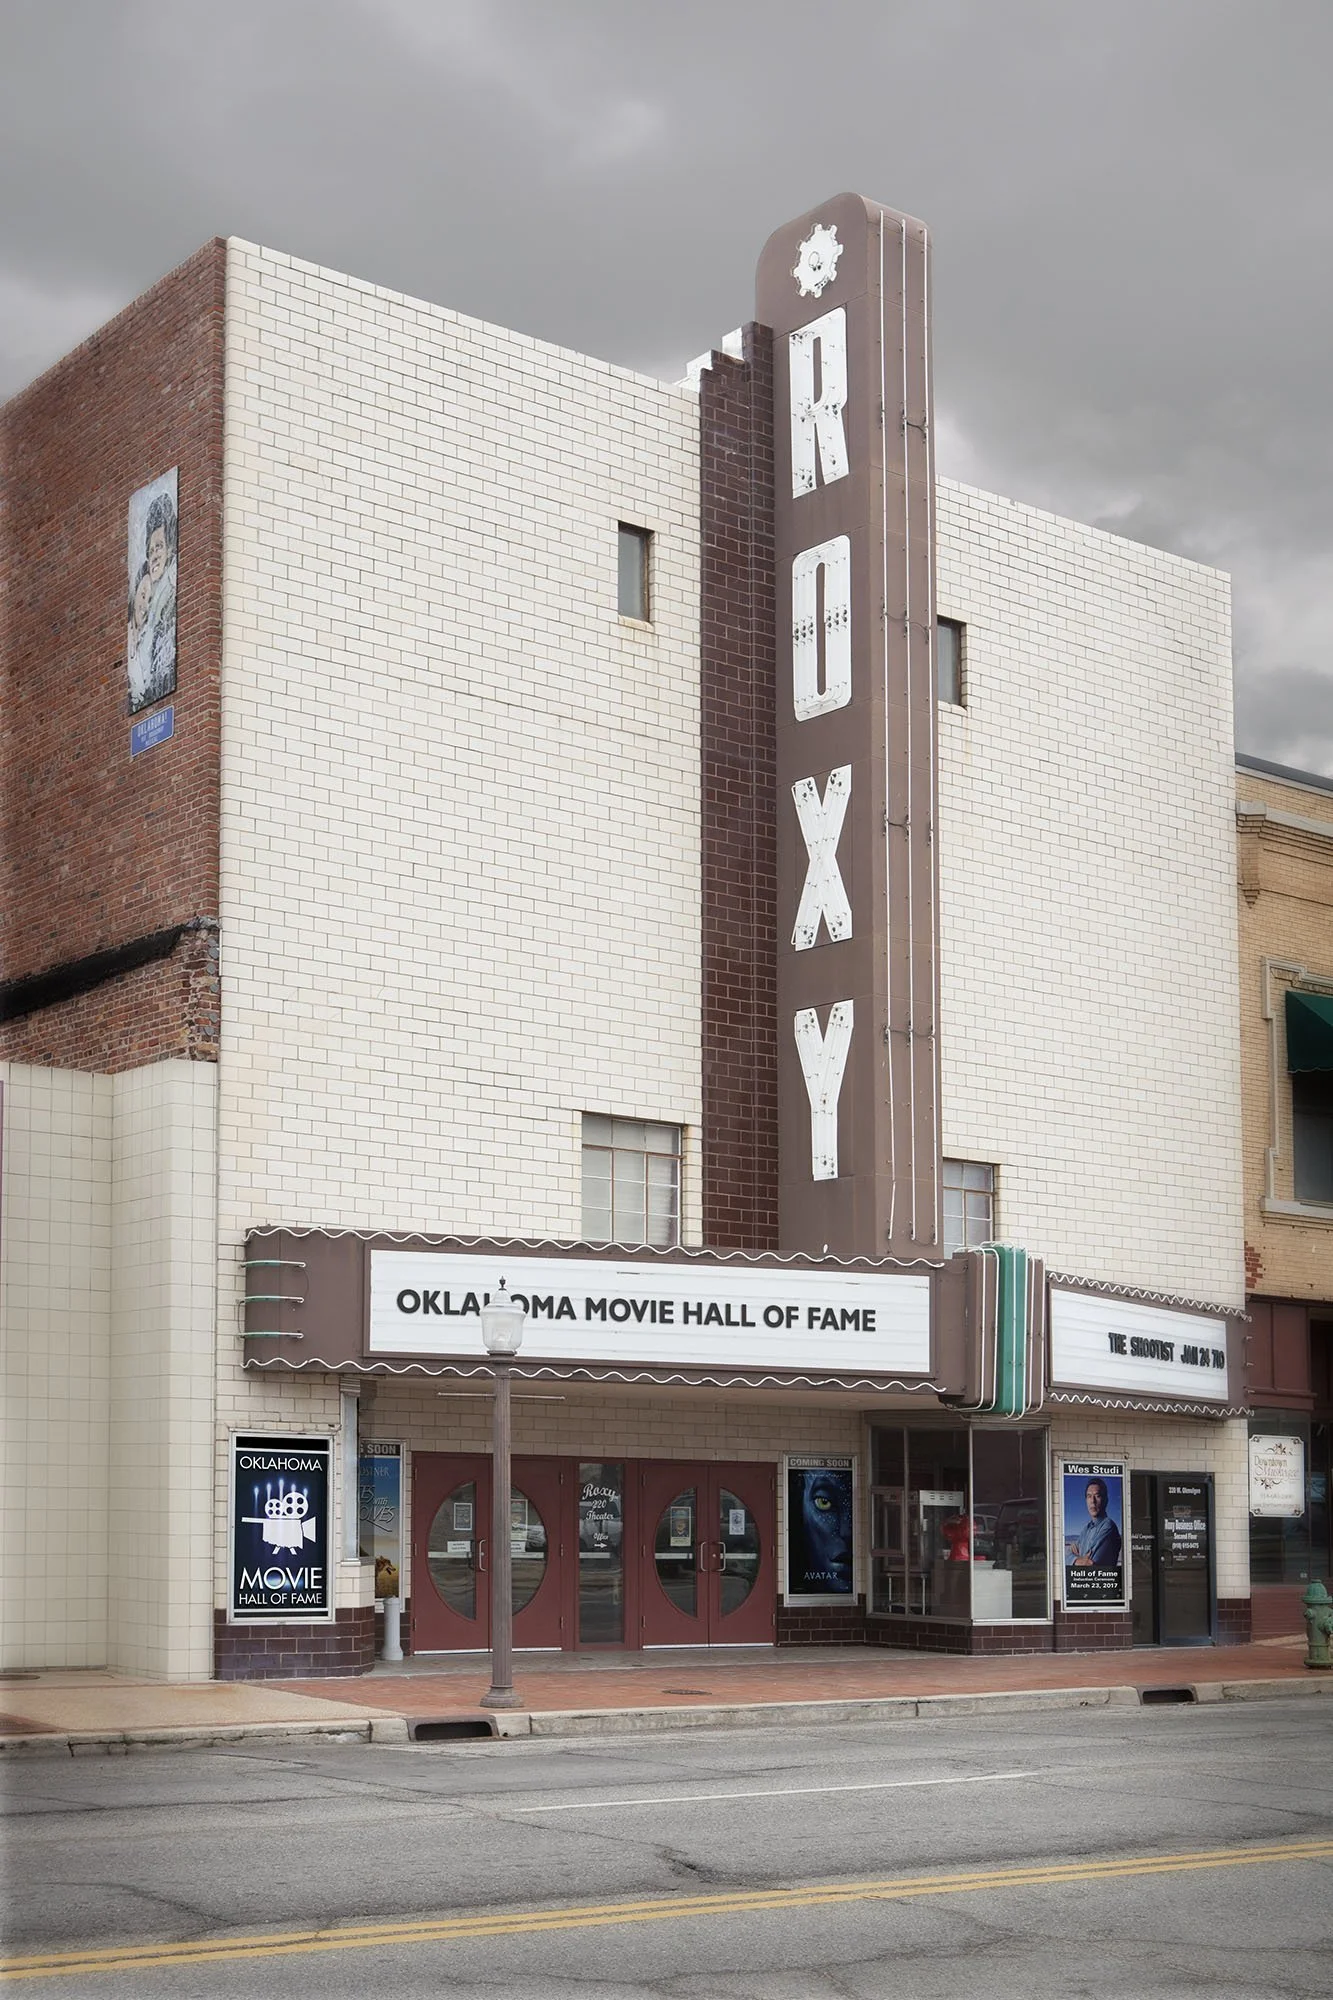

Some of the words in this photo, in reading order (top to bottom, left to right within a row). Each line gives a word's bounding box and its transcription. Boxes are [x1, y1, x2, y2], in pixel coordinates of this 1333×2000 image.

[788, 307, 855, 1182] ROXY
[396, 1288, 577, 1321] OKLAOMA
[585, 1297, 674, 1324] MOVIE
[683, 1301, 756, 1328] HALL
[763, 1304, 799, 1329] OF
[808, 1306, 876, 1332] FAME
[1108, 1332, 1127, 1355] THE
[1130, 1336, 1175, 1362] SHOOTIST
[367, 1444, 396, 1455] SOON
[239, 1456, 323, 1472] OKLAHOMA
[790, 1458, 825, 1467] COMING
[826, 1459, 849, 1468] SOON
[1068, 1465, 1090, 1474] Wes
[1092, 1465, 1119, 1475] Studi
[582, 1483, 617, 1502] Roxy
[592, 1500, 607, 1509] 220
[586, 1510, 614, 1521] Theater
[1175, 1519, 1193, 1531] Business
[1193, 1519, 1206, 1531] Office
[239, 1567, 323, 1590] MOVIE
[804, 1572, 838, 1581] AVATAR
[239, 1593, 268, 1605] HALL
[270, 1593, 288, 1605] OF
[291, 1592, 323, 1604] FAME
